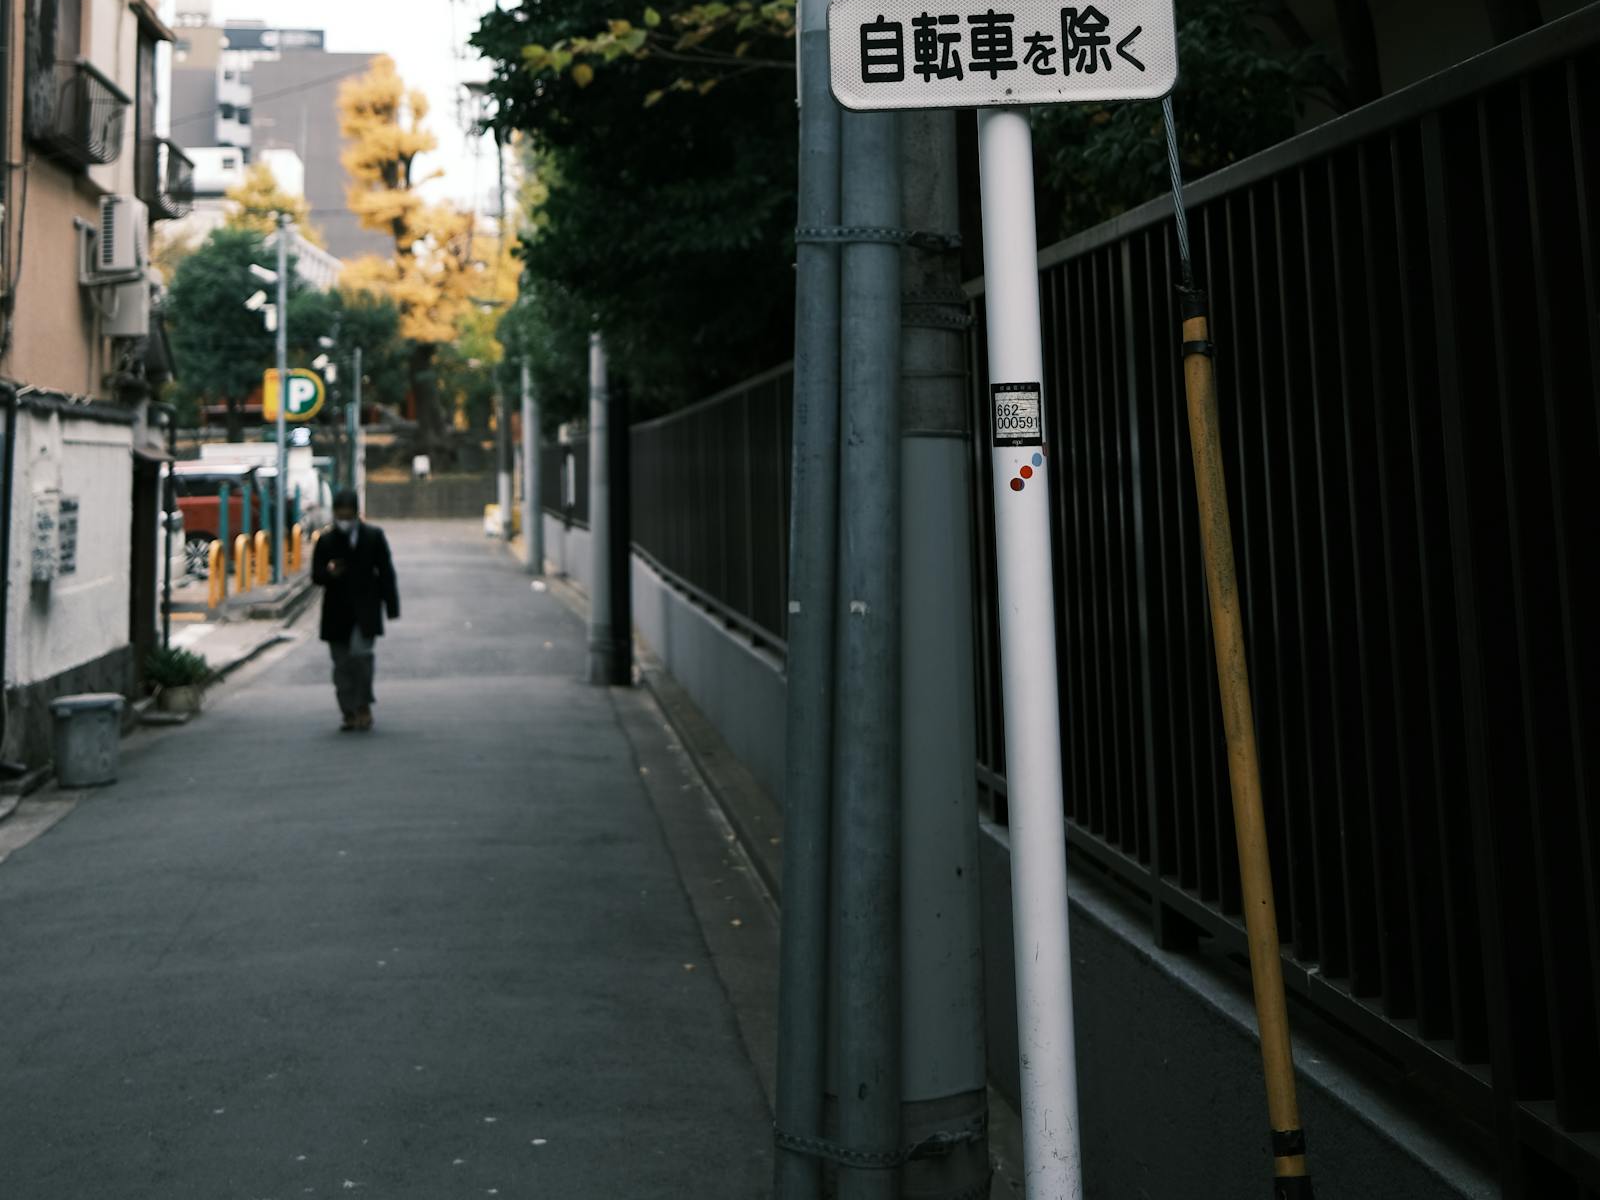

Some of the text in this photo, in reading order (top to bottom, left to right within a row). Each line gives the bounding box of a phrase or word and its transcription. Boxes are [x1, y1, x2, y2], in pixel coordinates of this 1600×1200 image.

[860, 4, 1146, 84] 自転車を除く
[288, 377, 316, 413] P
[997, 403, 1028, 417] 662-
[997, 416, 1038, 430] 000591
